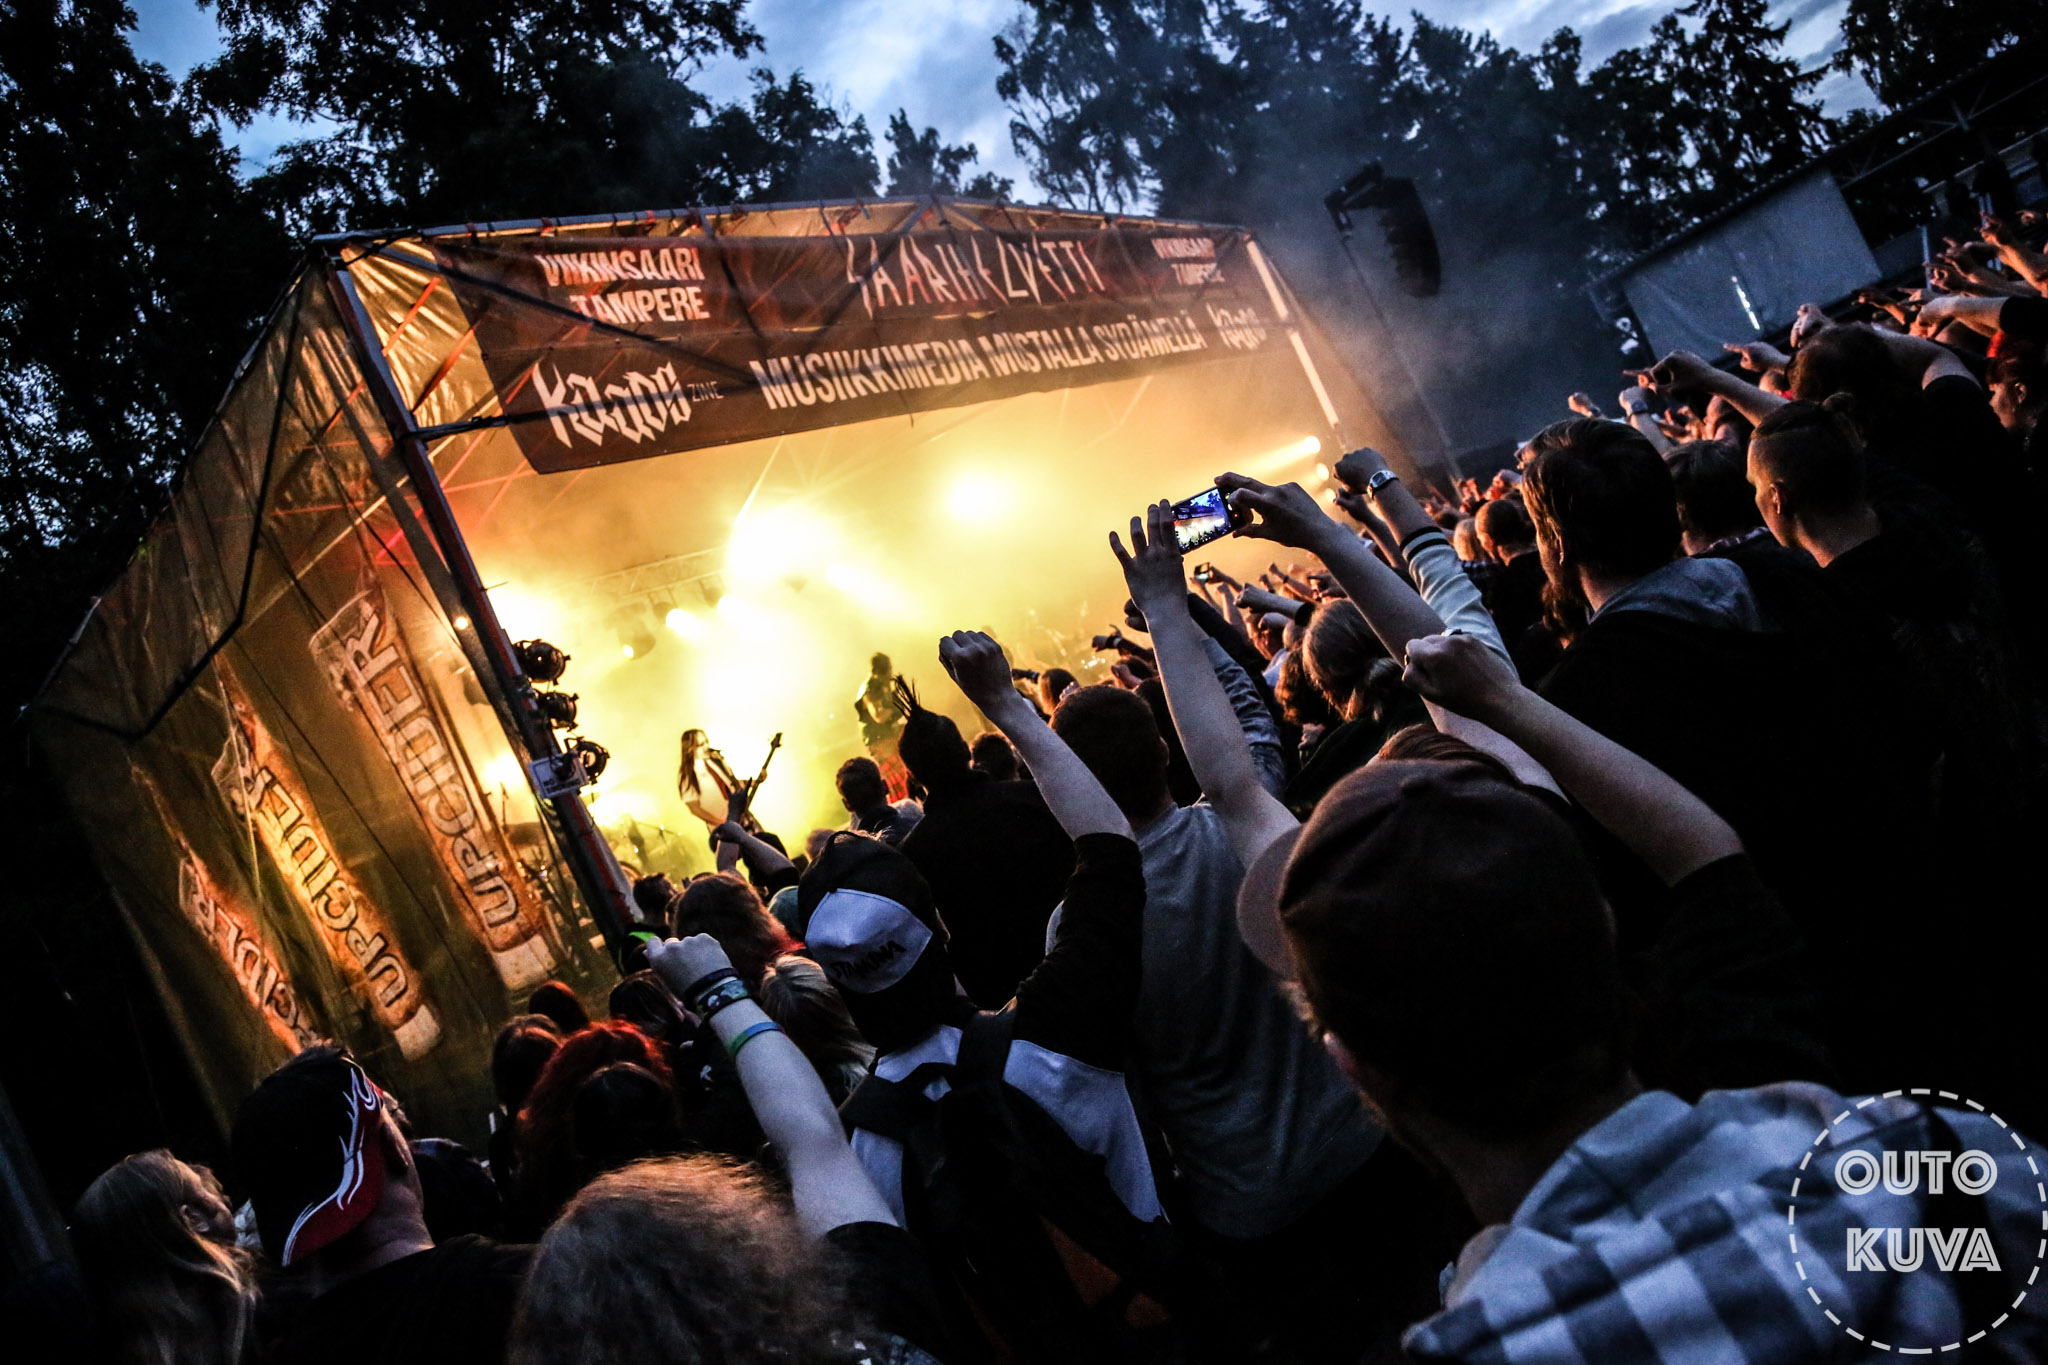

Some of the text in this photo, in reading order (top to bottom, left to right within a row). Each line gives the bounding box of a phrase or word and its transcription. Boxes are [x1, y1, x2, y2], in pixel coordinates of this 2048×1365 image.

[534, 248, 705, 287] VIIKINSAARI
[569, 287, 711, 325] TAMPERE
[749, 310, 1207, 410] MUSIIKKIMEDIA MUSTALLA SYDÄMELLÄ
